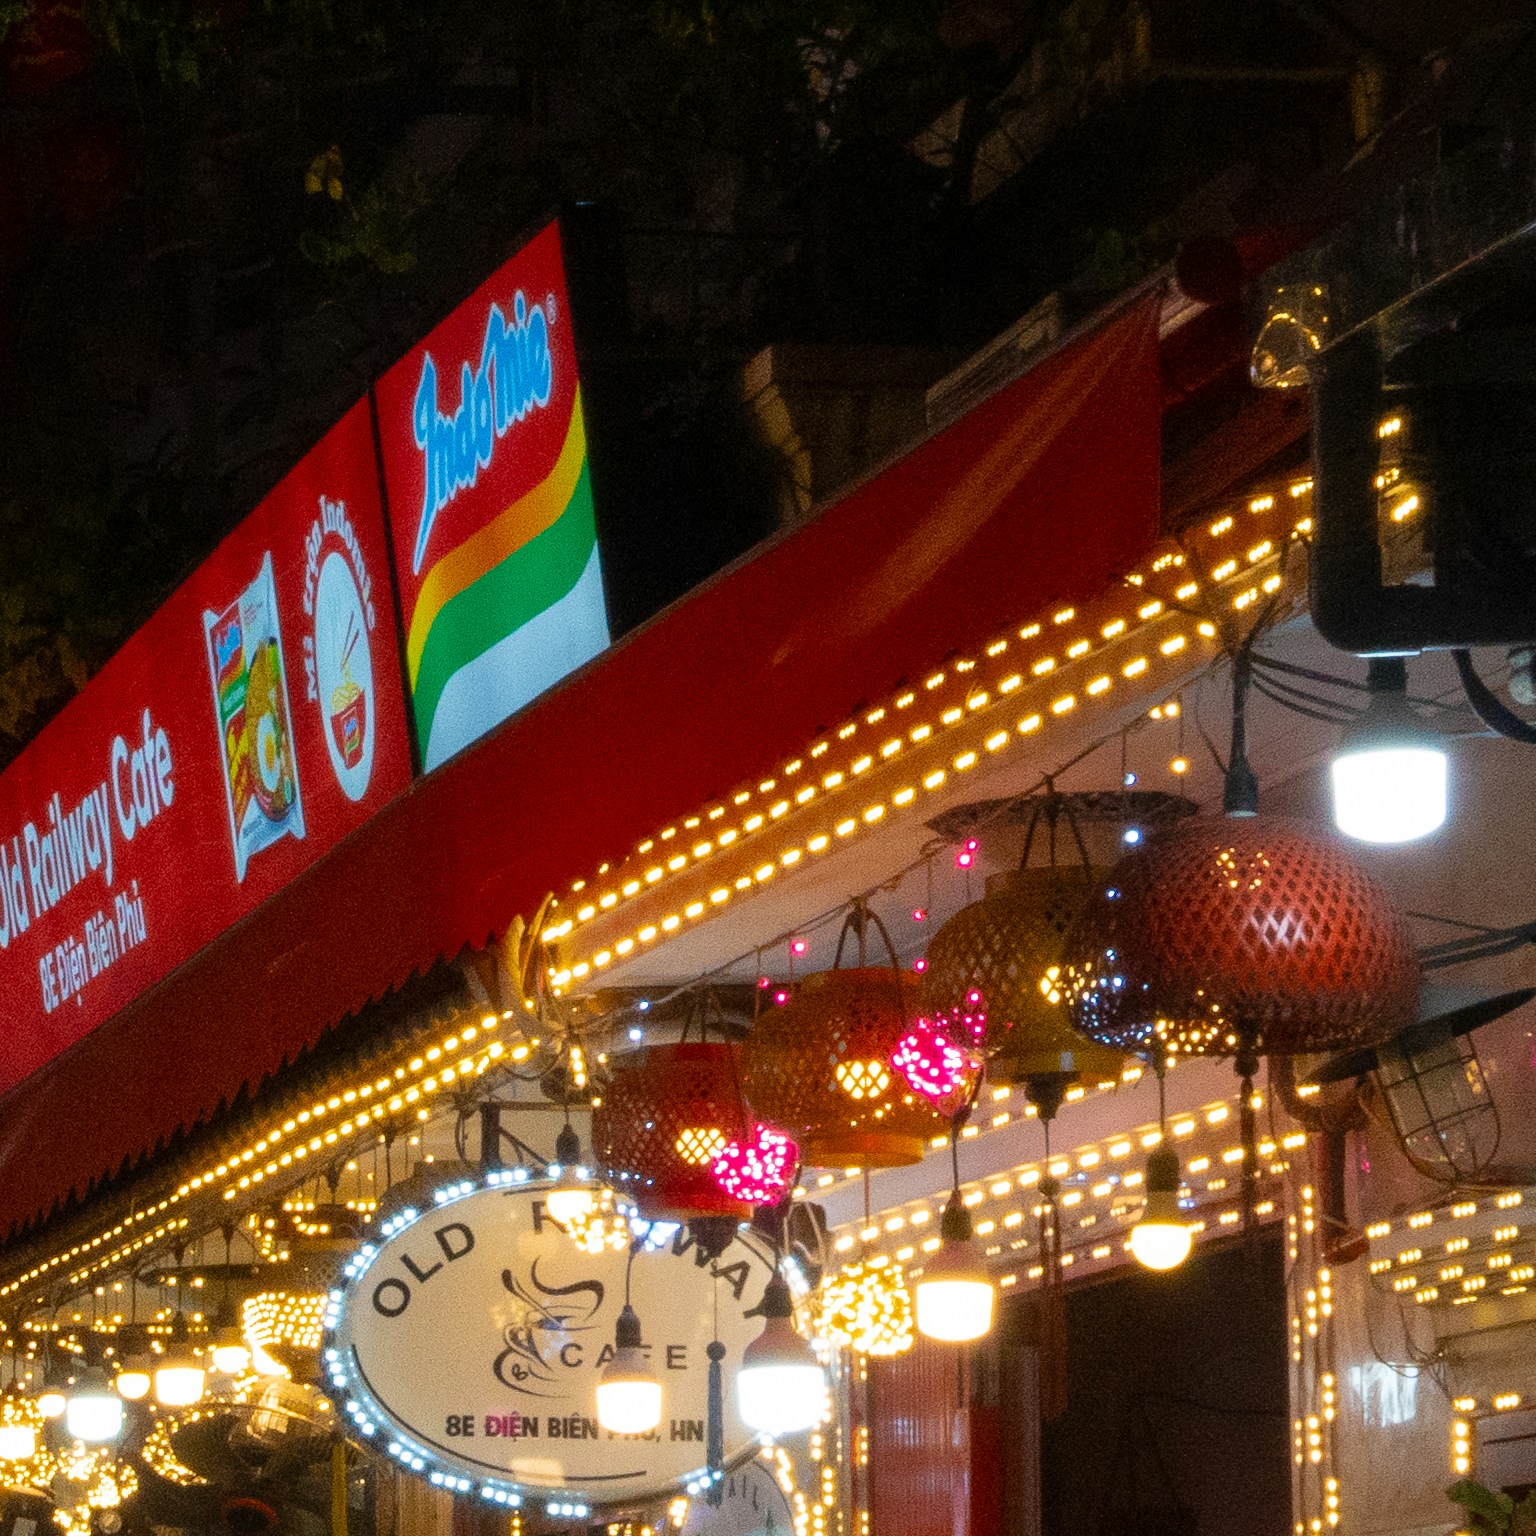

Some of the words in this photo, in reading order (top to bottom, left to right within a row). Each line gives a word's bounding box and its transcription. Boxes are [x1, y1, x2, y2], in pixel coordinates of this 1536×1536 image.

[22, 781, 116, 918] Railway
[109, 706, 176, 842] Cafe
[37, 953, 59, 1014] 8E
[54, 934, 89, 1008] Điện
[83, 909, 118, 979] Biên
[113, 877, 148, 955] Phủ
[371, 1220, 476, 1319] OLD
[445, 1414, 475, 1437] 8E
[483, 1410, 539, 1442] ĐIỆN
[547, 1412, 599, 1440] BIÊN
[668, 1418, 704, 1443] HN
